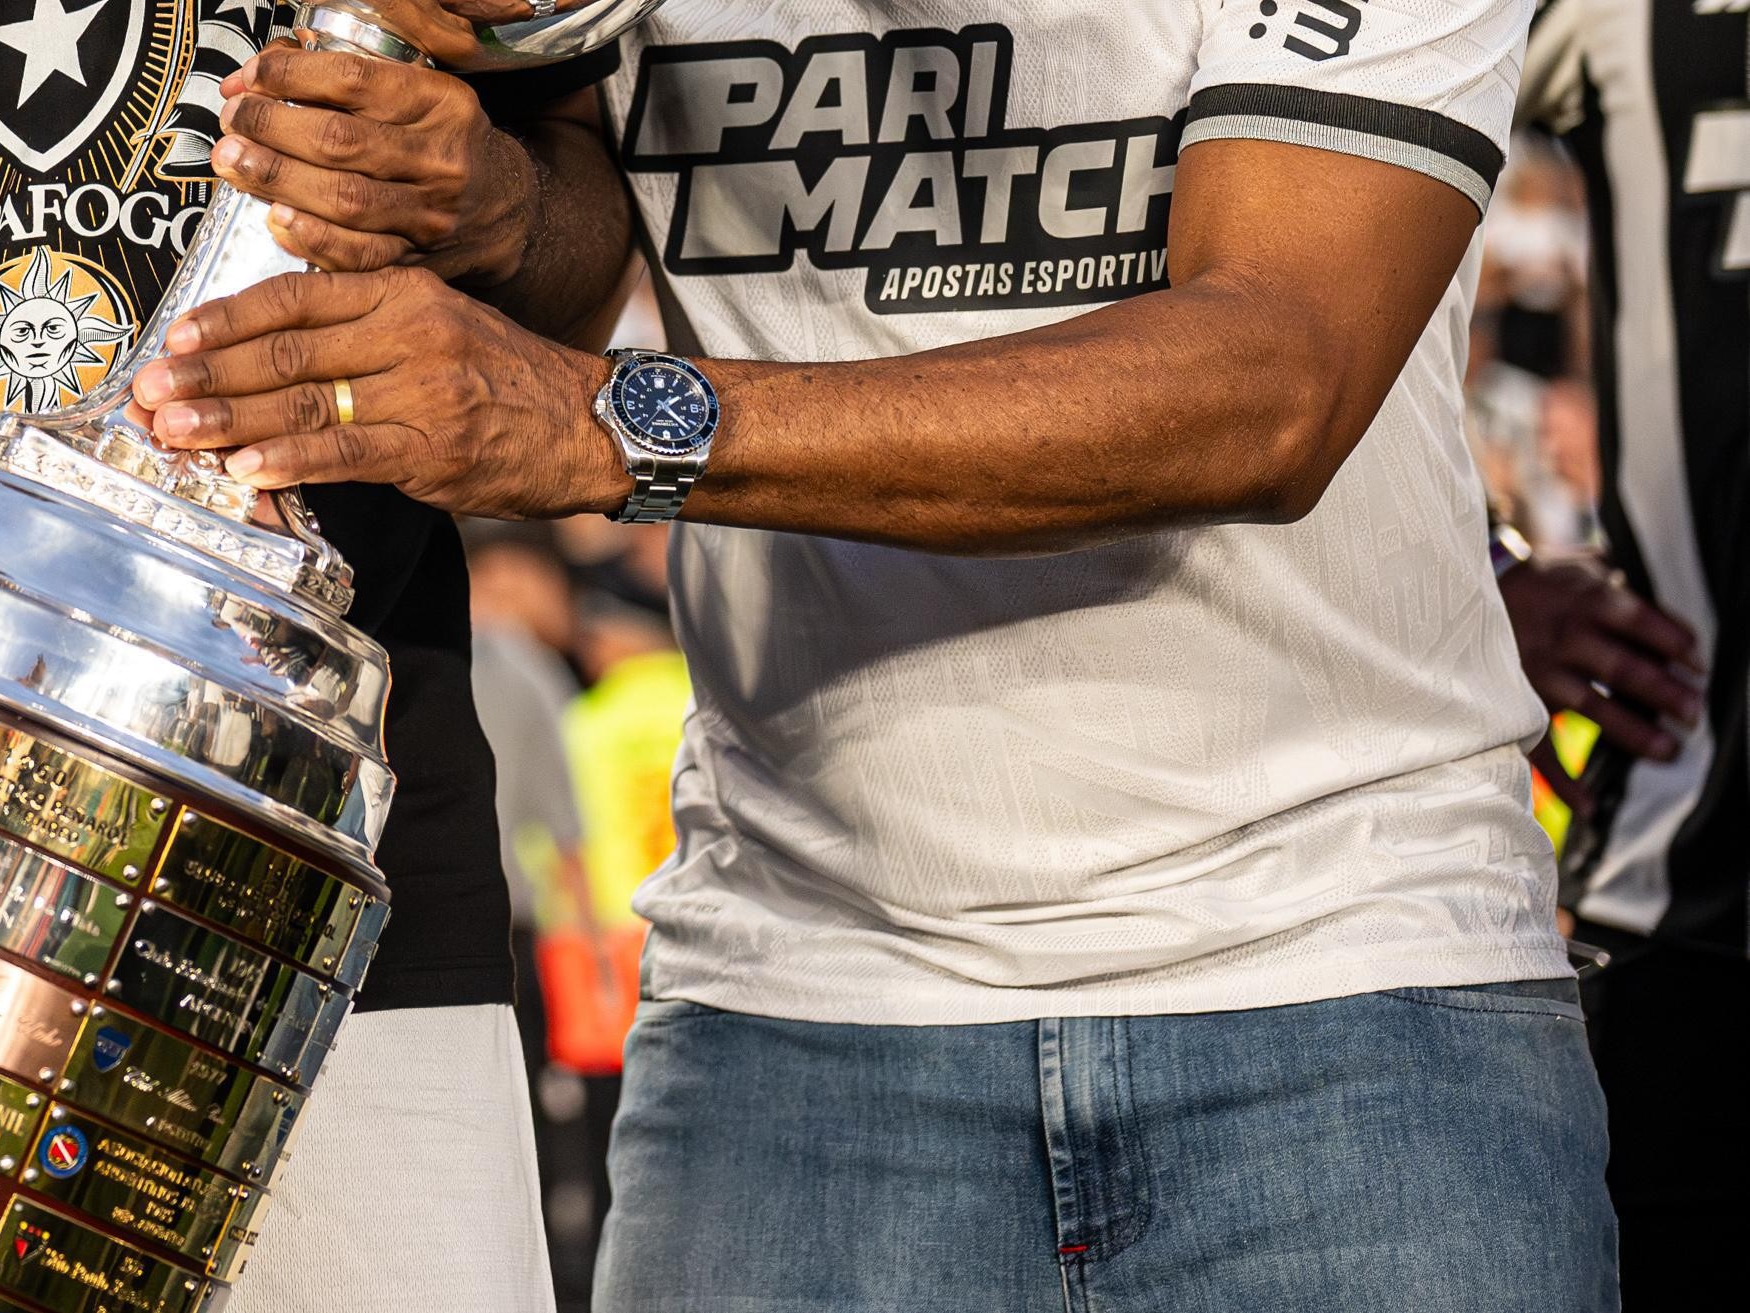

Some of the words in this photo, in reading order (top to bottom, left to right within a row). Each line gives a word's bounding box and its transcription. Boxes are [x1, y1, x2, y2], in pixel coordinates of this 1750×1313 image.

[634, 40, 999, 157] PARI
[679, 133, 1178, 260] MATCH
[879, 262, 1013, 301] APOSTAS
[1021, 247, 1168, 293] ESPORTIV
